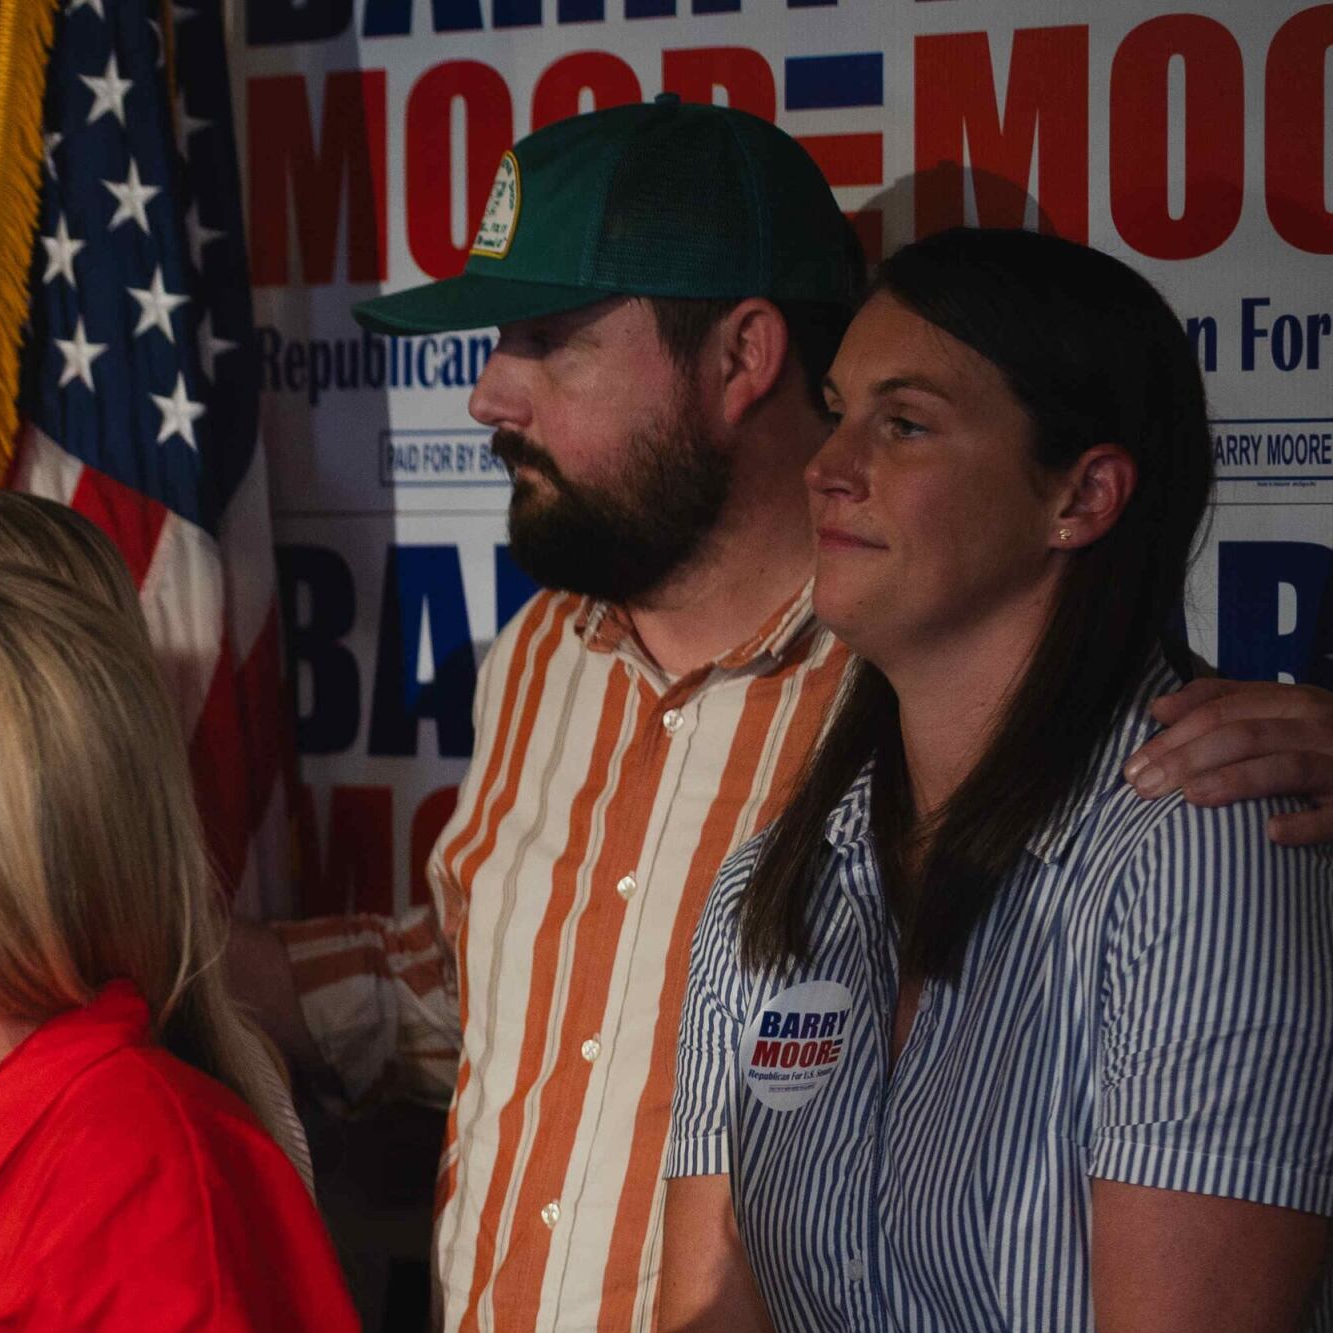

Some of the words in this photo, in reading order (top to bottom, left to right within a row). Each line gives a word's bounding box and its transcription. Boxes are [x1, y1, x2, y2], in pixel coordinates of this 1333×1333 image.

[247, 47, 884, 285] MOE
[1241, 298, 1331, 371] For
[386, 442, 419, 472] PAID
[423, 442, 450, 472] FOR
[456, 442, 476, 472] BY
[1213, 434, 1263, 466] ARRY
[1267, 433, 1332, 465] MOORE
[759, 1008, 851, 1039] BARRY
[751, 1039, 844, 1069] MOORE
[748, 1068, 790, 1081] Republican
[791, 1071, 803, 1081] For
